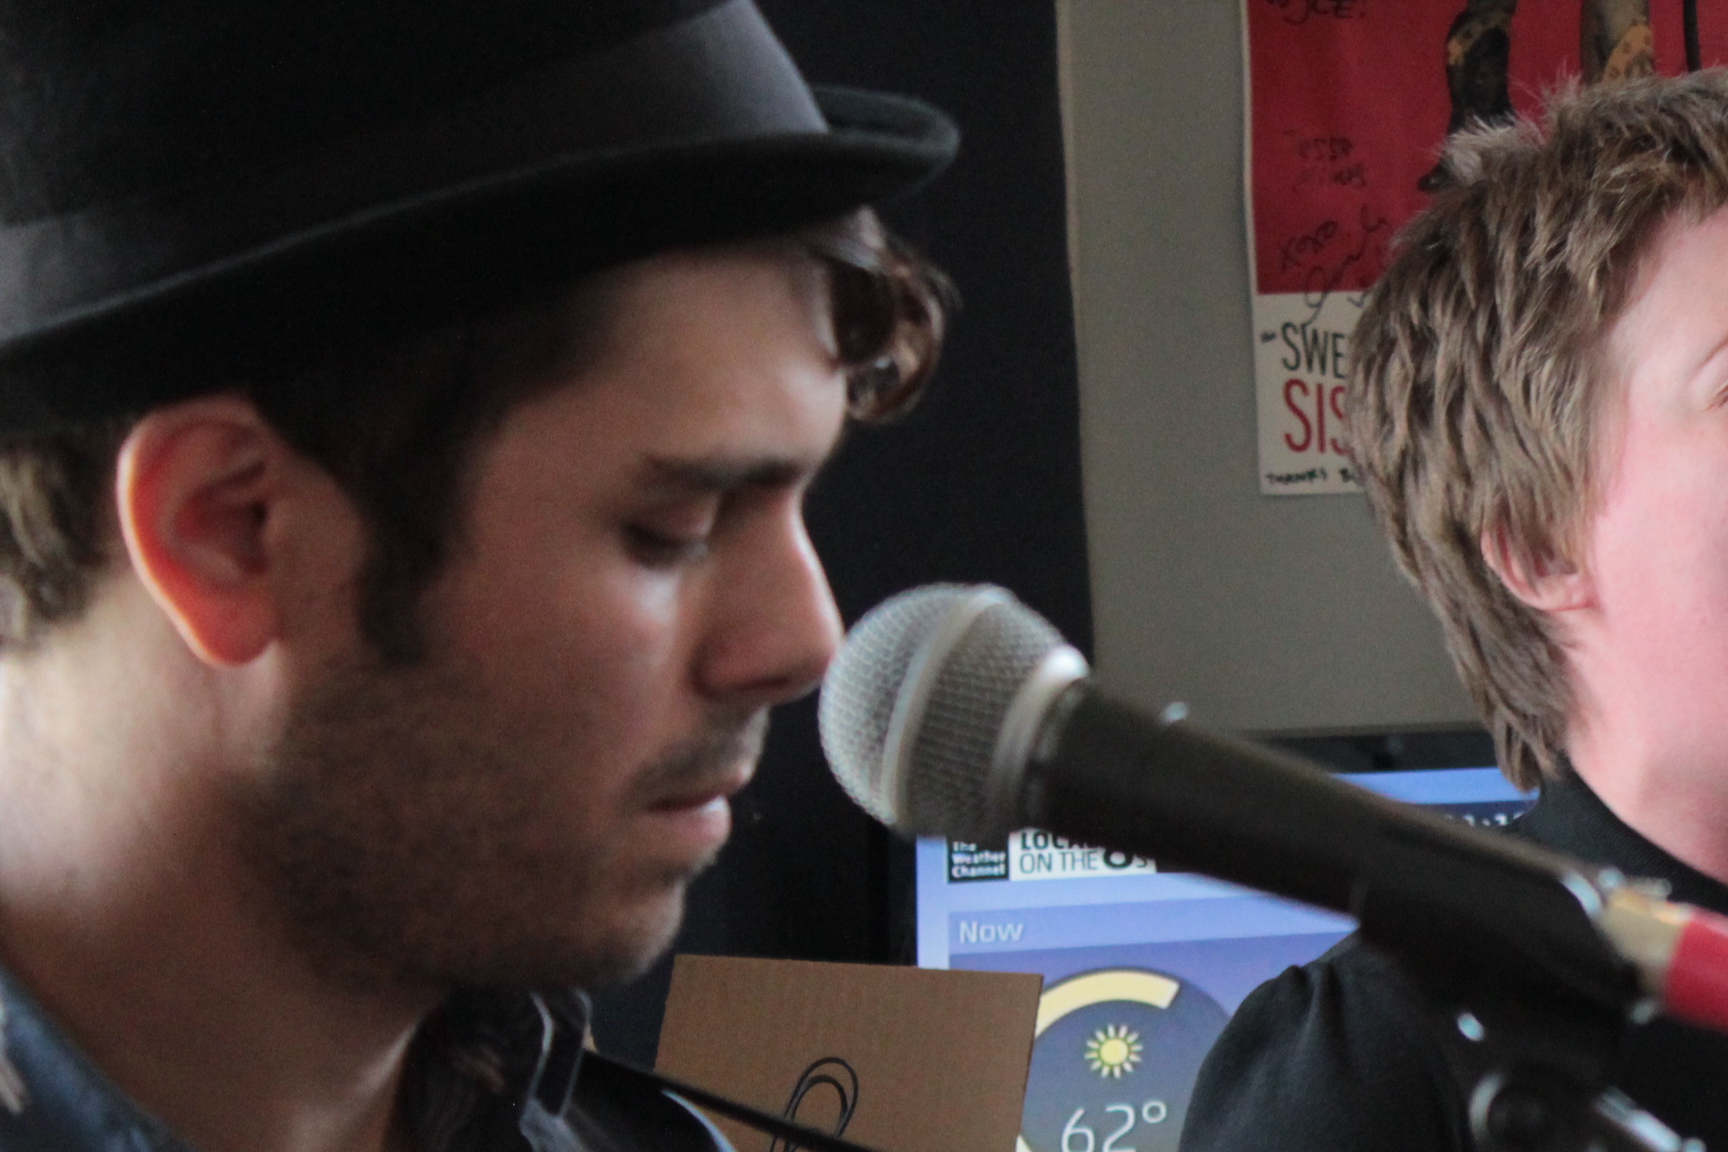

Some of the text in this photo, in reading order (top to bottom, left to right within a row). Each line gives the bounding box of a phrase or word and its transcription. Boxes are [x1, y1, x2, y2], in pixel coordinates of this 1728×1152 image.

[951, 850, 1007, 864] Weather
[1019, 852, 1052, 874] ON
[1060, 850, 1099, 872] THE
[951, 864, 1006, 878] Channel
[959, 920, 1024, 945] Now
